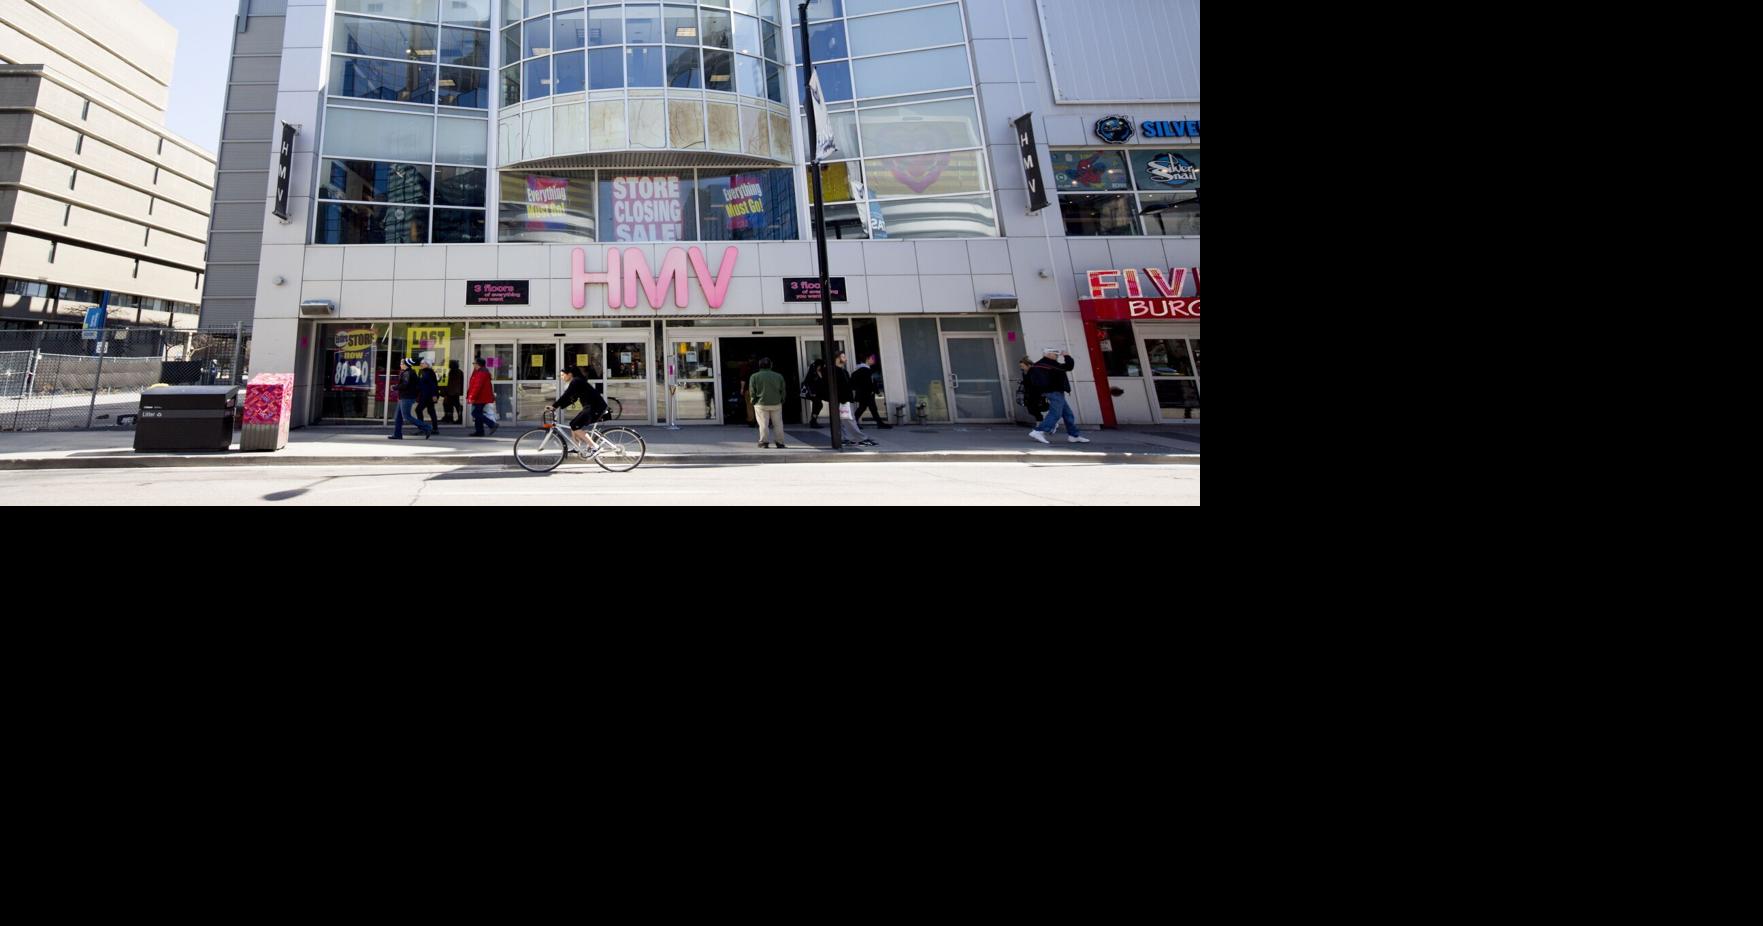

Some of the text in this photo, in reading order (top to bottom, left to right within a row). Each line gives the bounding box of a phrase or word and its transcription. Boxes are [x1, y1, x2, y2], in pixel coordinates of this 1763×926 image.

[1141, 120, 1200, 138] SILVE
[277, 140, 289, 202] HMV
[1020, 132, 1036, 193] HMV
[527, 185, 567, 202] Everything
[613, 176, 680, 200] STORE
[723, 182, 763, 201] Everything
[614, 199, 682, 223] CLOSING
[725, 198, 764, 218] Must Go!
[571, 246, 738, 309] HMV
[790, 281, 821, 289] 3 floo
[1086, 267, 1200, 299] FIV
[474, 284, 514, 293] 3 floors
[412, 330, 446, 346] LAST
